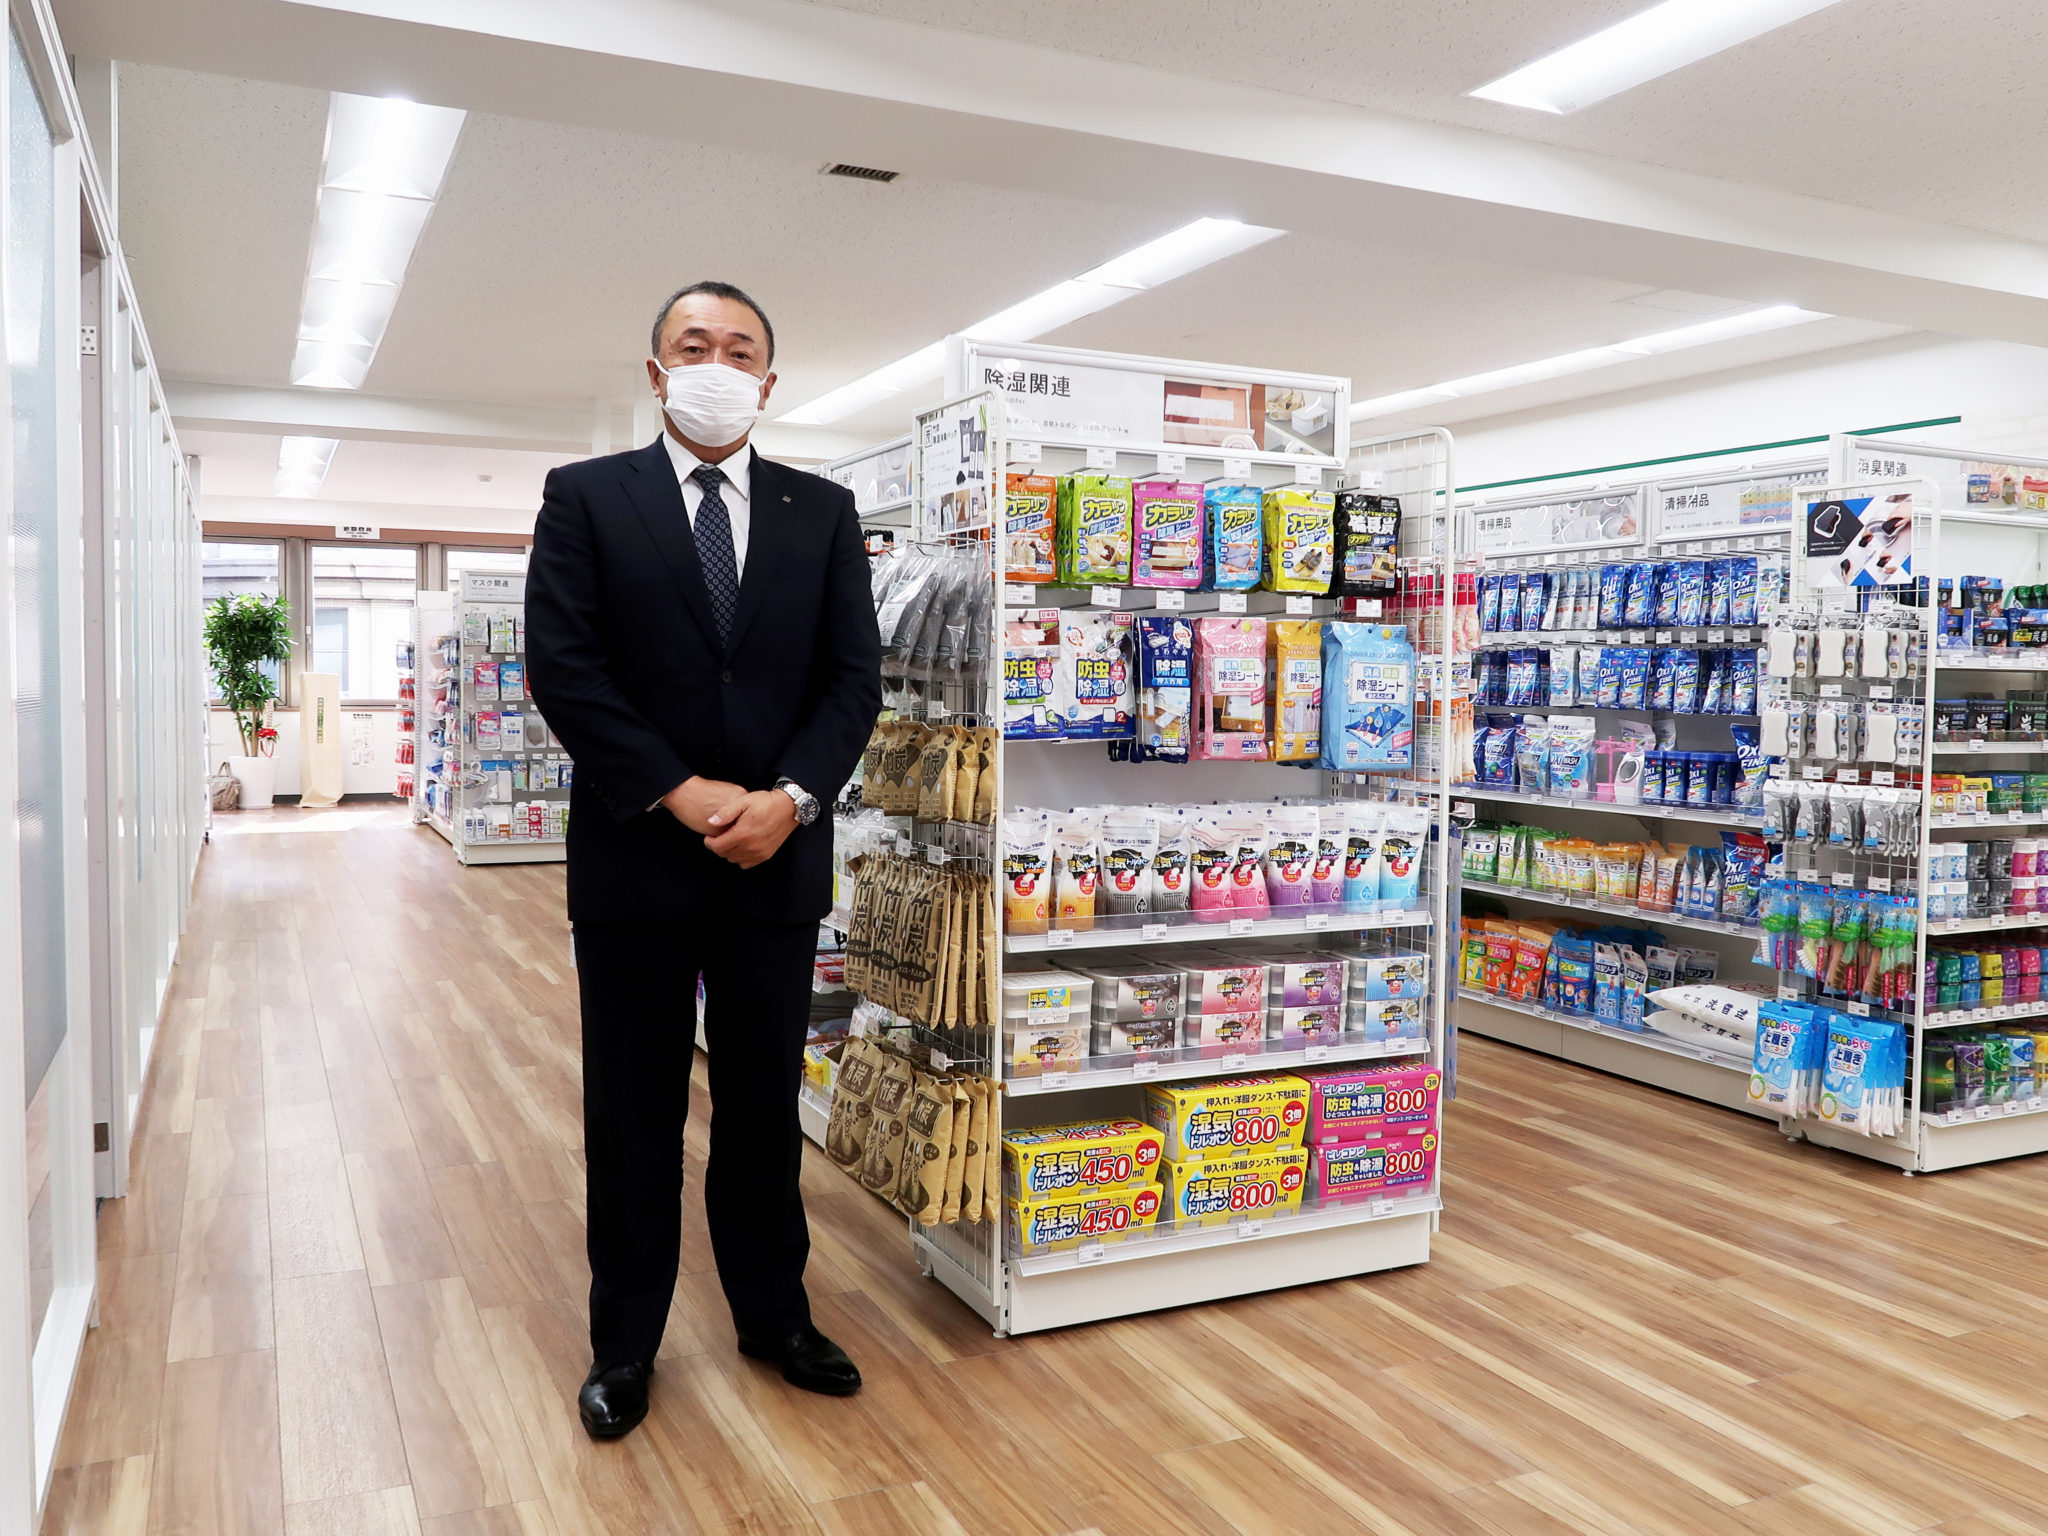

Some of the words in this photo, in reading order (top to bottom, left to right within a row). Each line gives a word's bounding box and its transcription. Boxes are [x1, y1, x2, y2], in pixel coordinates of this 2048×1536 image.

[984, 368, 1071, 397] 除湿関連
[1083, 499, 1126, 522] カラリン
[1664, 493, 1709, 511] 清掃用品
[1146, 505, 1197, 527] カラリン
[1223, 509, 1257, 533] カラリン
[1287, 513, 1331, 535] カラリン
[1348, 515, 1397, 535] 備長炭
[1478, 517, 1512, 531] 清掃用品
[471, 579, 509, 588] マスク関連
[1660, 581, 1674, 593] OXI
[1732, 576, 1750, 590] OXI
[1735, 585, 1756, 599] FINE
[1004, 660, 1037, 679] 防虫
[1077, 660, 1110, 679] 防虫
[1155, 659, 1187, 677] 除湿
[1218, 671, 1260, 682] 除湿シート
[1600, 667, 1614, 678] OXI
[1623, 667, 1638, 680] OXI
[1656, 667, 1671, 678] OXI
[1290, 672, 1320, 683] 除湿シート
[1356, 679, 1404, 692] 除湿シート
[1602, 675, 1620, 687] FINE
[1626, 675, 1644, 687] FINE
[1658, 675, 1674, 687] FINE
[1005, 679, 1038, 698] 除湿
[1077, 679, 1110, 697] 除湿
[885, 748, 907, 774] 竹炭
[1741, 757, 1767, 768] FINE
[1725, 873, 1748, 887] FINE
[1384, 1088, 1427, 1115] 800
[1285, 1108, 1302, 1123] 3個
[1326, 1108, 1382, 1118] ひとつにしちゃいました
[1190, 1110, 1234, 1136] 湿気
[1232, 1115, 1279, 1146] 800
[1190, 1132, 1233, 1150] トルポン
[1034, 1151, 1081, 1177] 湿気
[1138, 1148, 1156, 1162] 3個
[1385, 1149, 1425, 1177] 800
[1080, 1154, 1133, 1185] 450
[1330, 1171, 1383, 1184] ひとつにしちゃいました
[1033, 1174, 1080, 1192] トルポン
[1188, 1176, 1232, 1202] 湿気
[1282, 1174, 1300, 1188] 3個
[1229, 1181, 1278, 1212] 800
[1136, 1199, 1155, 1213] 3個
[1187, 1198, 1230, 1217] トルポン
[1034, 1204, 1081, 1230] 湿気
[1080, 1206, 1131, 1236] 450
[1034, 1227, 1080, 1246] トルポン
